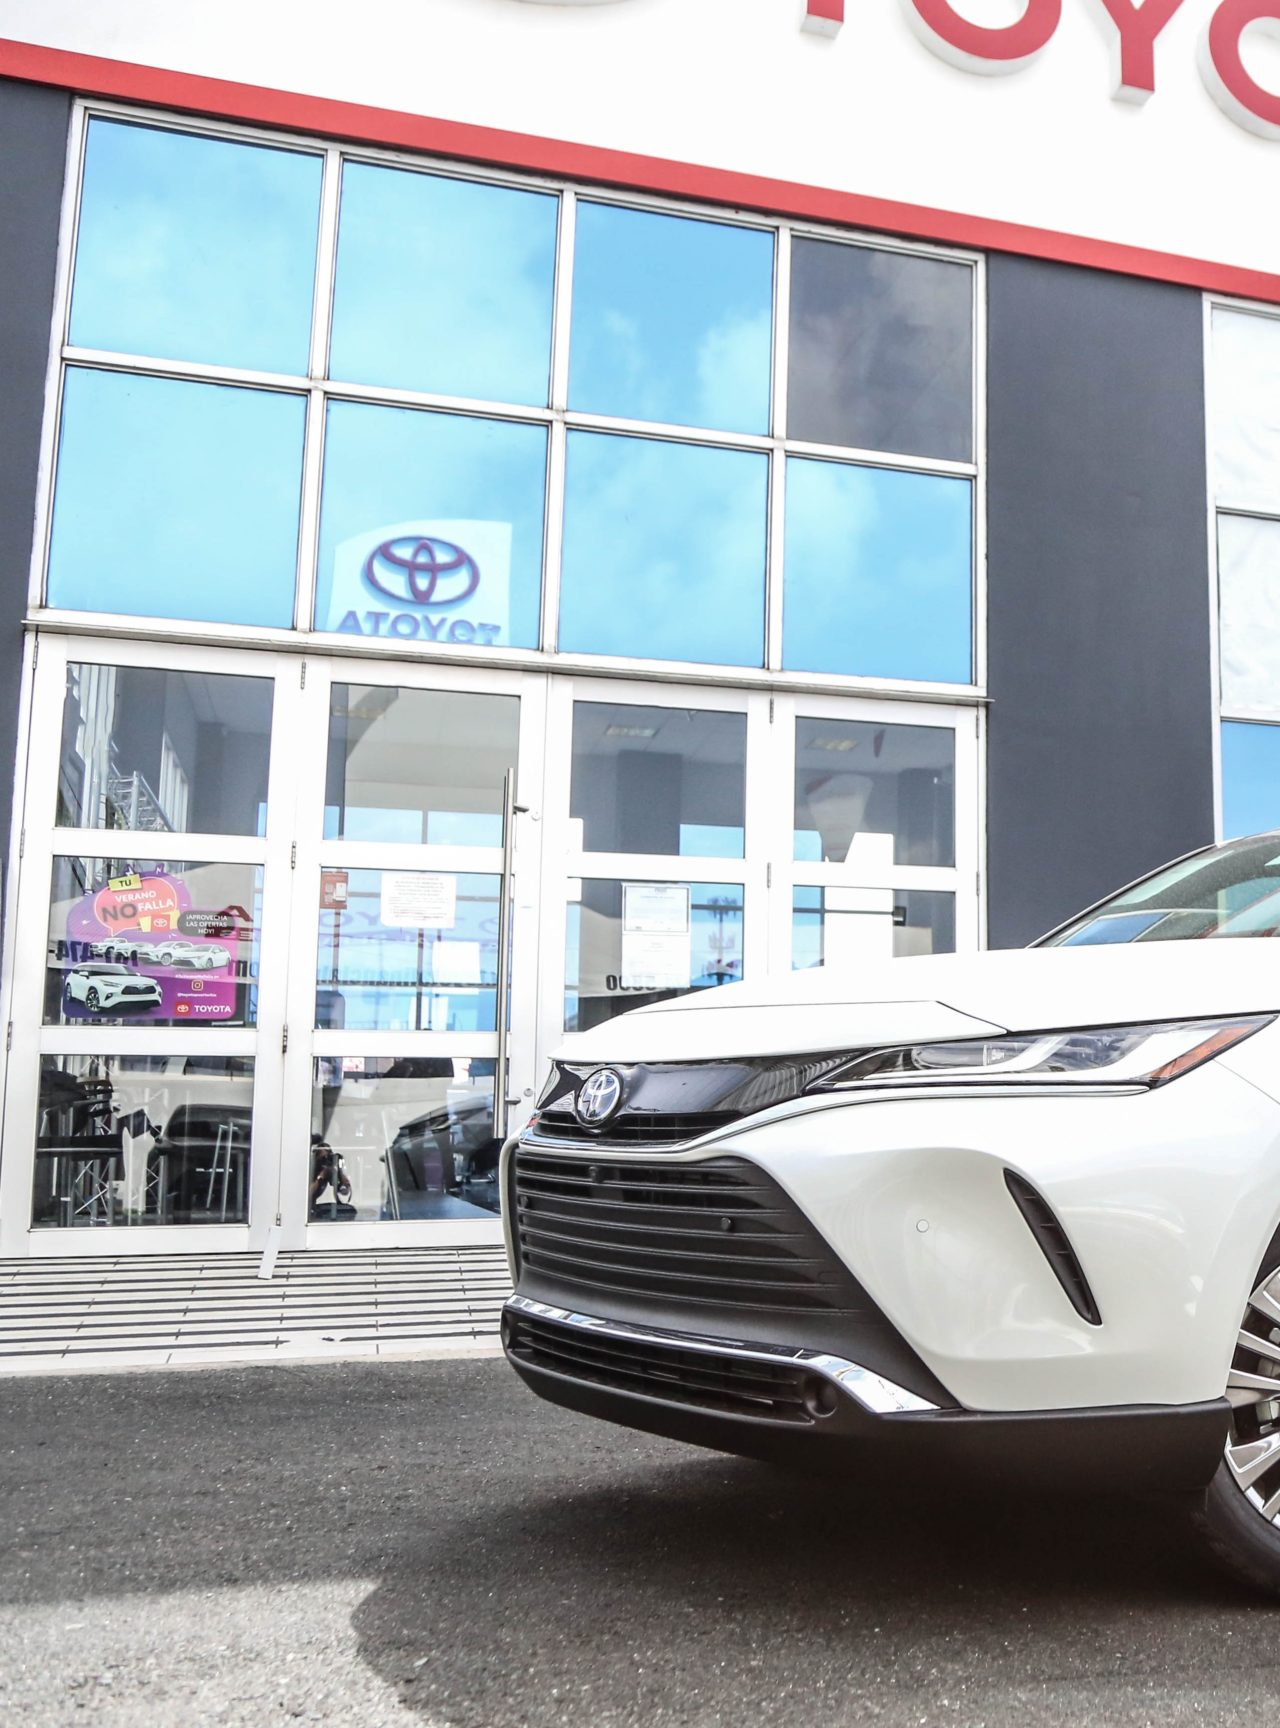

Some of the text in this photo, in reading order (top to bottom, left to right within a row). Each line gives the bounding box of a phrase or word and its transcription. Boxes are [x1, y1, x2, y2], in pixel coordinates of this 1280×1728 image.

[119, 879, 132, 888] TU
[115, 890, 157, 903] VERANO
[101, 898, 175, 923] NO FALLA
[194, 1004, 232, 1013] TOYOTA
